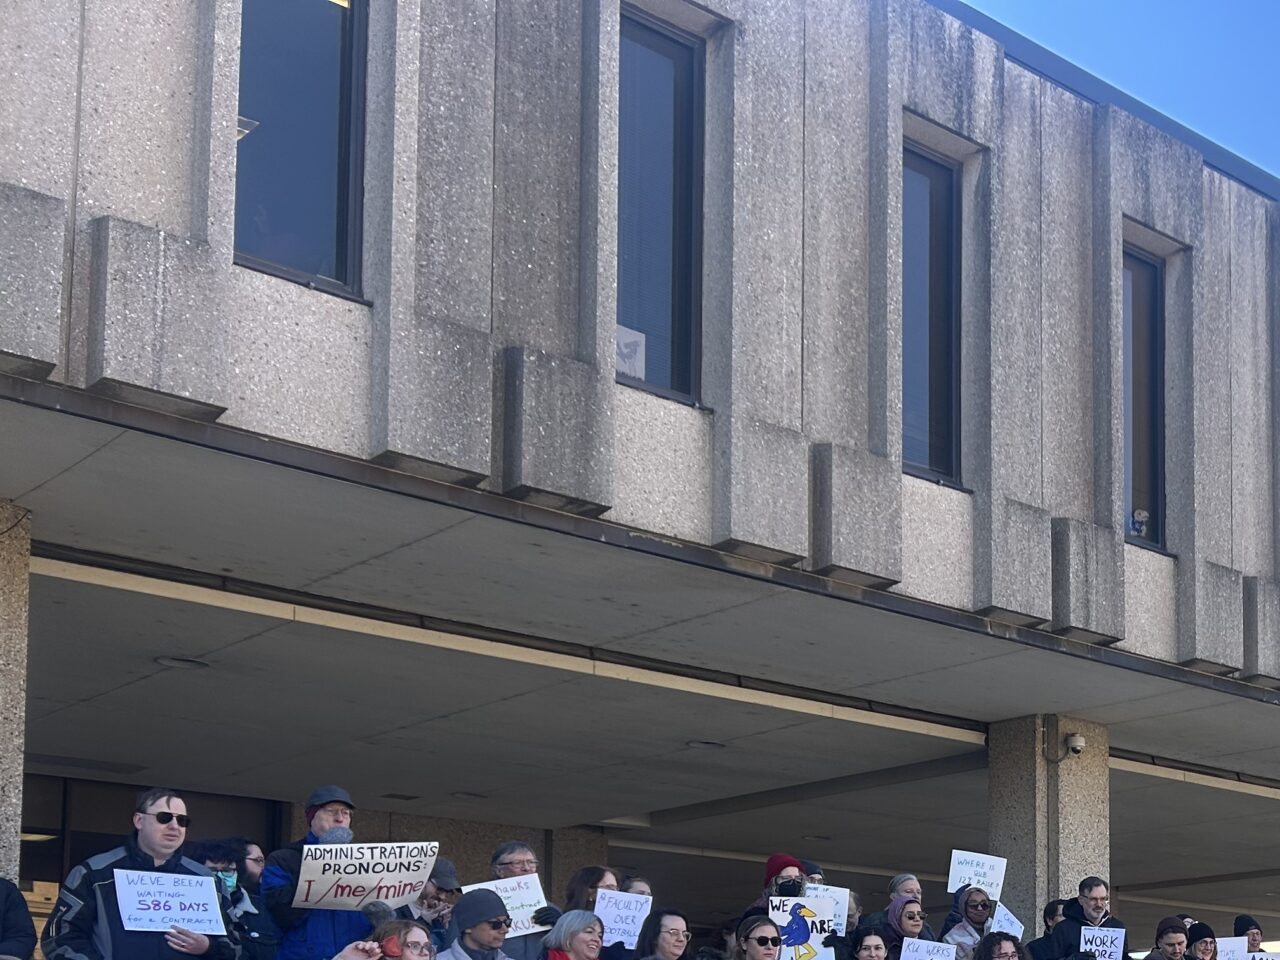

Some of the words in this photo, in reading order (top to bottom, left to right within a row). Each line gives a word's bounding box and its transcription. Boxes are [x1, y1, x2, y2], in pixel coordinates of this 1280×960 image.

[304, 842, 438, 861] ADMINISTRATION'S
[322, 861, 427, 875] PRONOUNS:
[173, 878, 204, 887] BEEN
[136, 900, 172, 911] 586
[180, 902, 209, 911] DAYS
[770, 899, 790, 913] WE
[810, 919, 833, 934] ARE
[1084, 934, 1118, 948] WORK
